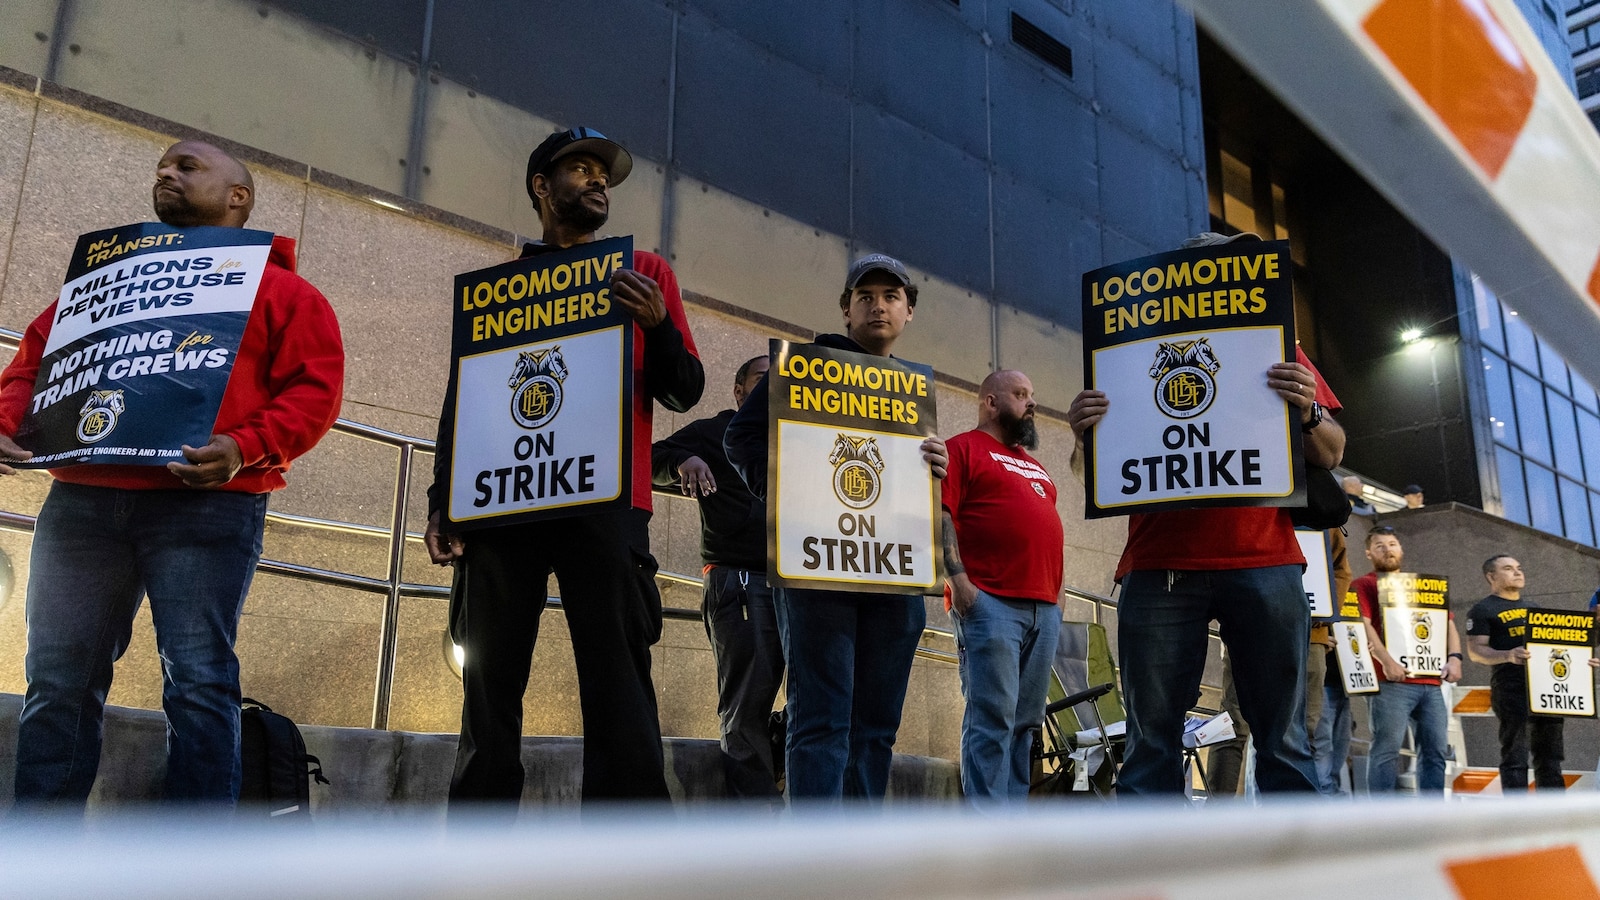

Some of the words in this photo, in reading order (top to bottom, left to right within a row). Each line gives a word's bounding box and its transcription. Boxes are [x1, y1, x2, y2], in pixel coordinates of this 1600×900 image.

[86, 233, 184, 267] TRANSIT:
[88, 234, 118, 255] NJ
[70, 257, 213, 302] MILLIONS
[215, 258, 242, 274] for
[462, 251, 624, 311] LOCOMOTIVE
[1092, 253, 1279, 306] LOCOMOTIVE
[56, 272, 247, 325] PENTHOUSE
[90, 292, 194, 323] VIEWS
[1104, 287, 1267, 334] ENGINEERS
[472, 288, 611, 342] ENGINEERS
[48, 330, 173, 384] NOTHING
[176, 330, 215, 353] for
[32, 364, 103, 415] TRAIN
[107, 348, 229, 381] CREWS
[778, 351, 927, 397] LOCOMOTIVE
[790, 385, 919, 425] ENGINEERS
[514, 431, 555, 461] ON
[1162, 422, 1210, 450] ON
[54, 448, 93, 461] LOCOMOTIVE
[93, 447, 138, 456] ENGINEERS
[138, 449, 156, 457] AND
[473, 454, 595, 508] STRIKE
[1121, 449, 1262, 495] STRIKE
[838, 513, 876, 537] ON
[802, 536, 914, 576] STRIKE
[1381, 577, 1447, 592] LOOMOTIVE
[1387, 591, 1445, 605] EGINEERS
[1528, 612, 1593, 628] LOCOMOTIVE
[1531, 627, 1589, 642] ENGINEERS
[1400, 655, 1442, 671] STRIKE
[1416, 645, 1431, 655] ON
[1349, 672, 1375, 688] STRIKE
[1355, 660, 1365, 671] ON
[1540, 694, 1584, 710] STRIKE
[1553, 683, 1569, 693] ON
